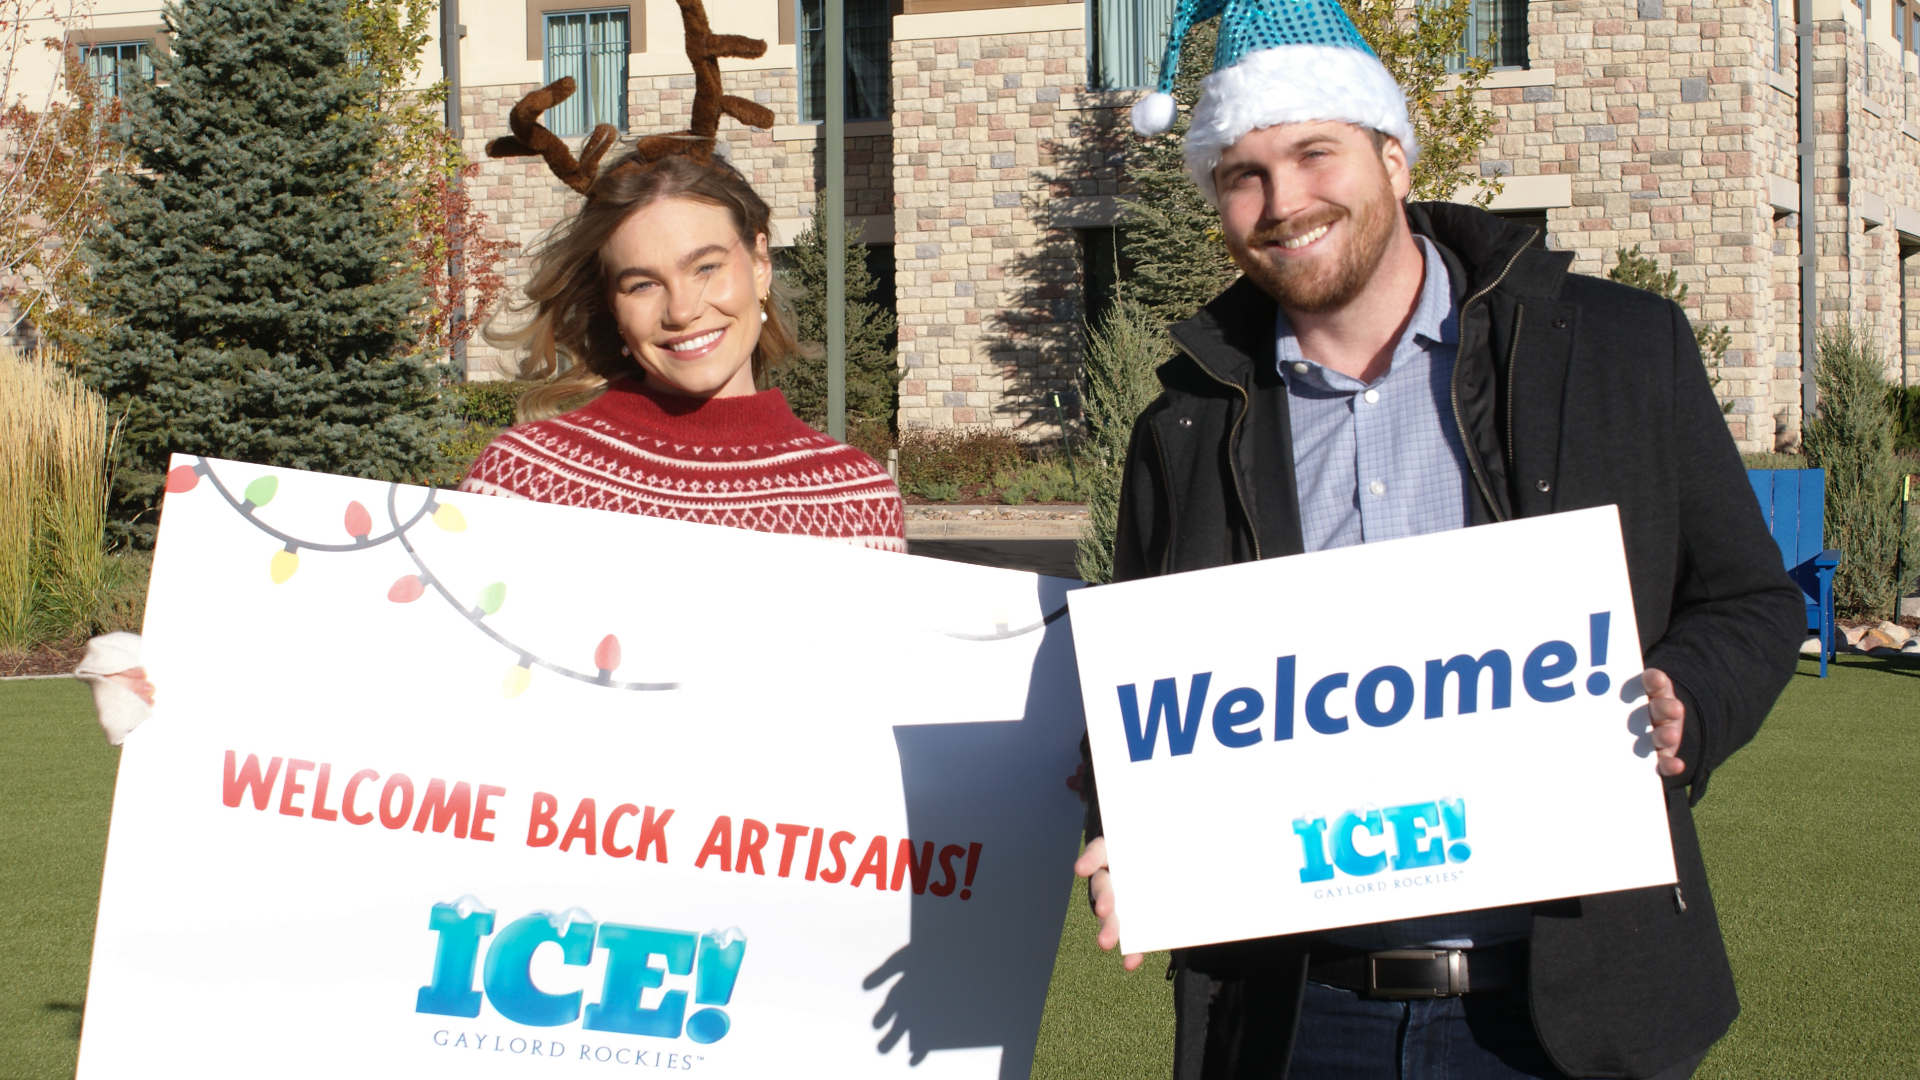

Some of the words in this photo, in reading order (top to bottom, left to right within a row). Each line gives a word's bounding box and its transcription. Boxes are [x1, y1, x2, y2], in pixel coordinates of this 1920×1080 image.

[1116, 611, 1612, 763] Welcome!
[222, 749, 506, 842] WELCOME
[526, 792, 675, 865] BACK
[694, 814, 983, 901] ARTISANS!
[1291, 791, 1473, 884] ICE!
[1313, 881, 1387, 899] GAYLORD
[415, 893, 748, 1045] ICE!
[432, 1029, 566, 1058] GAYLORD
